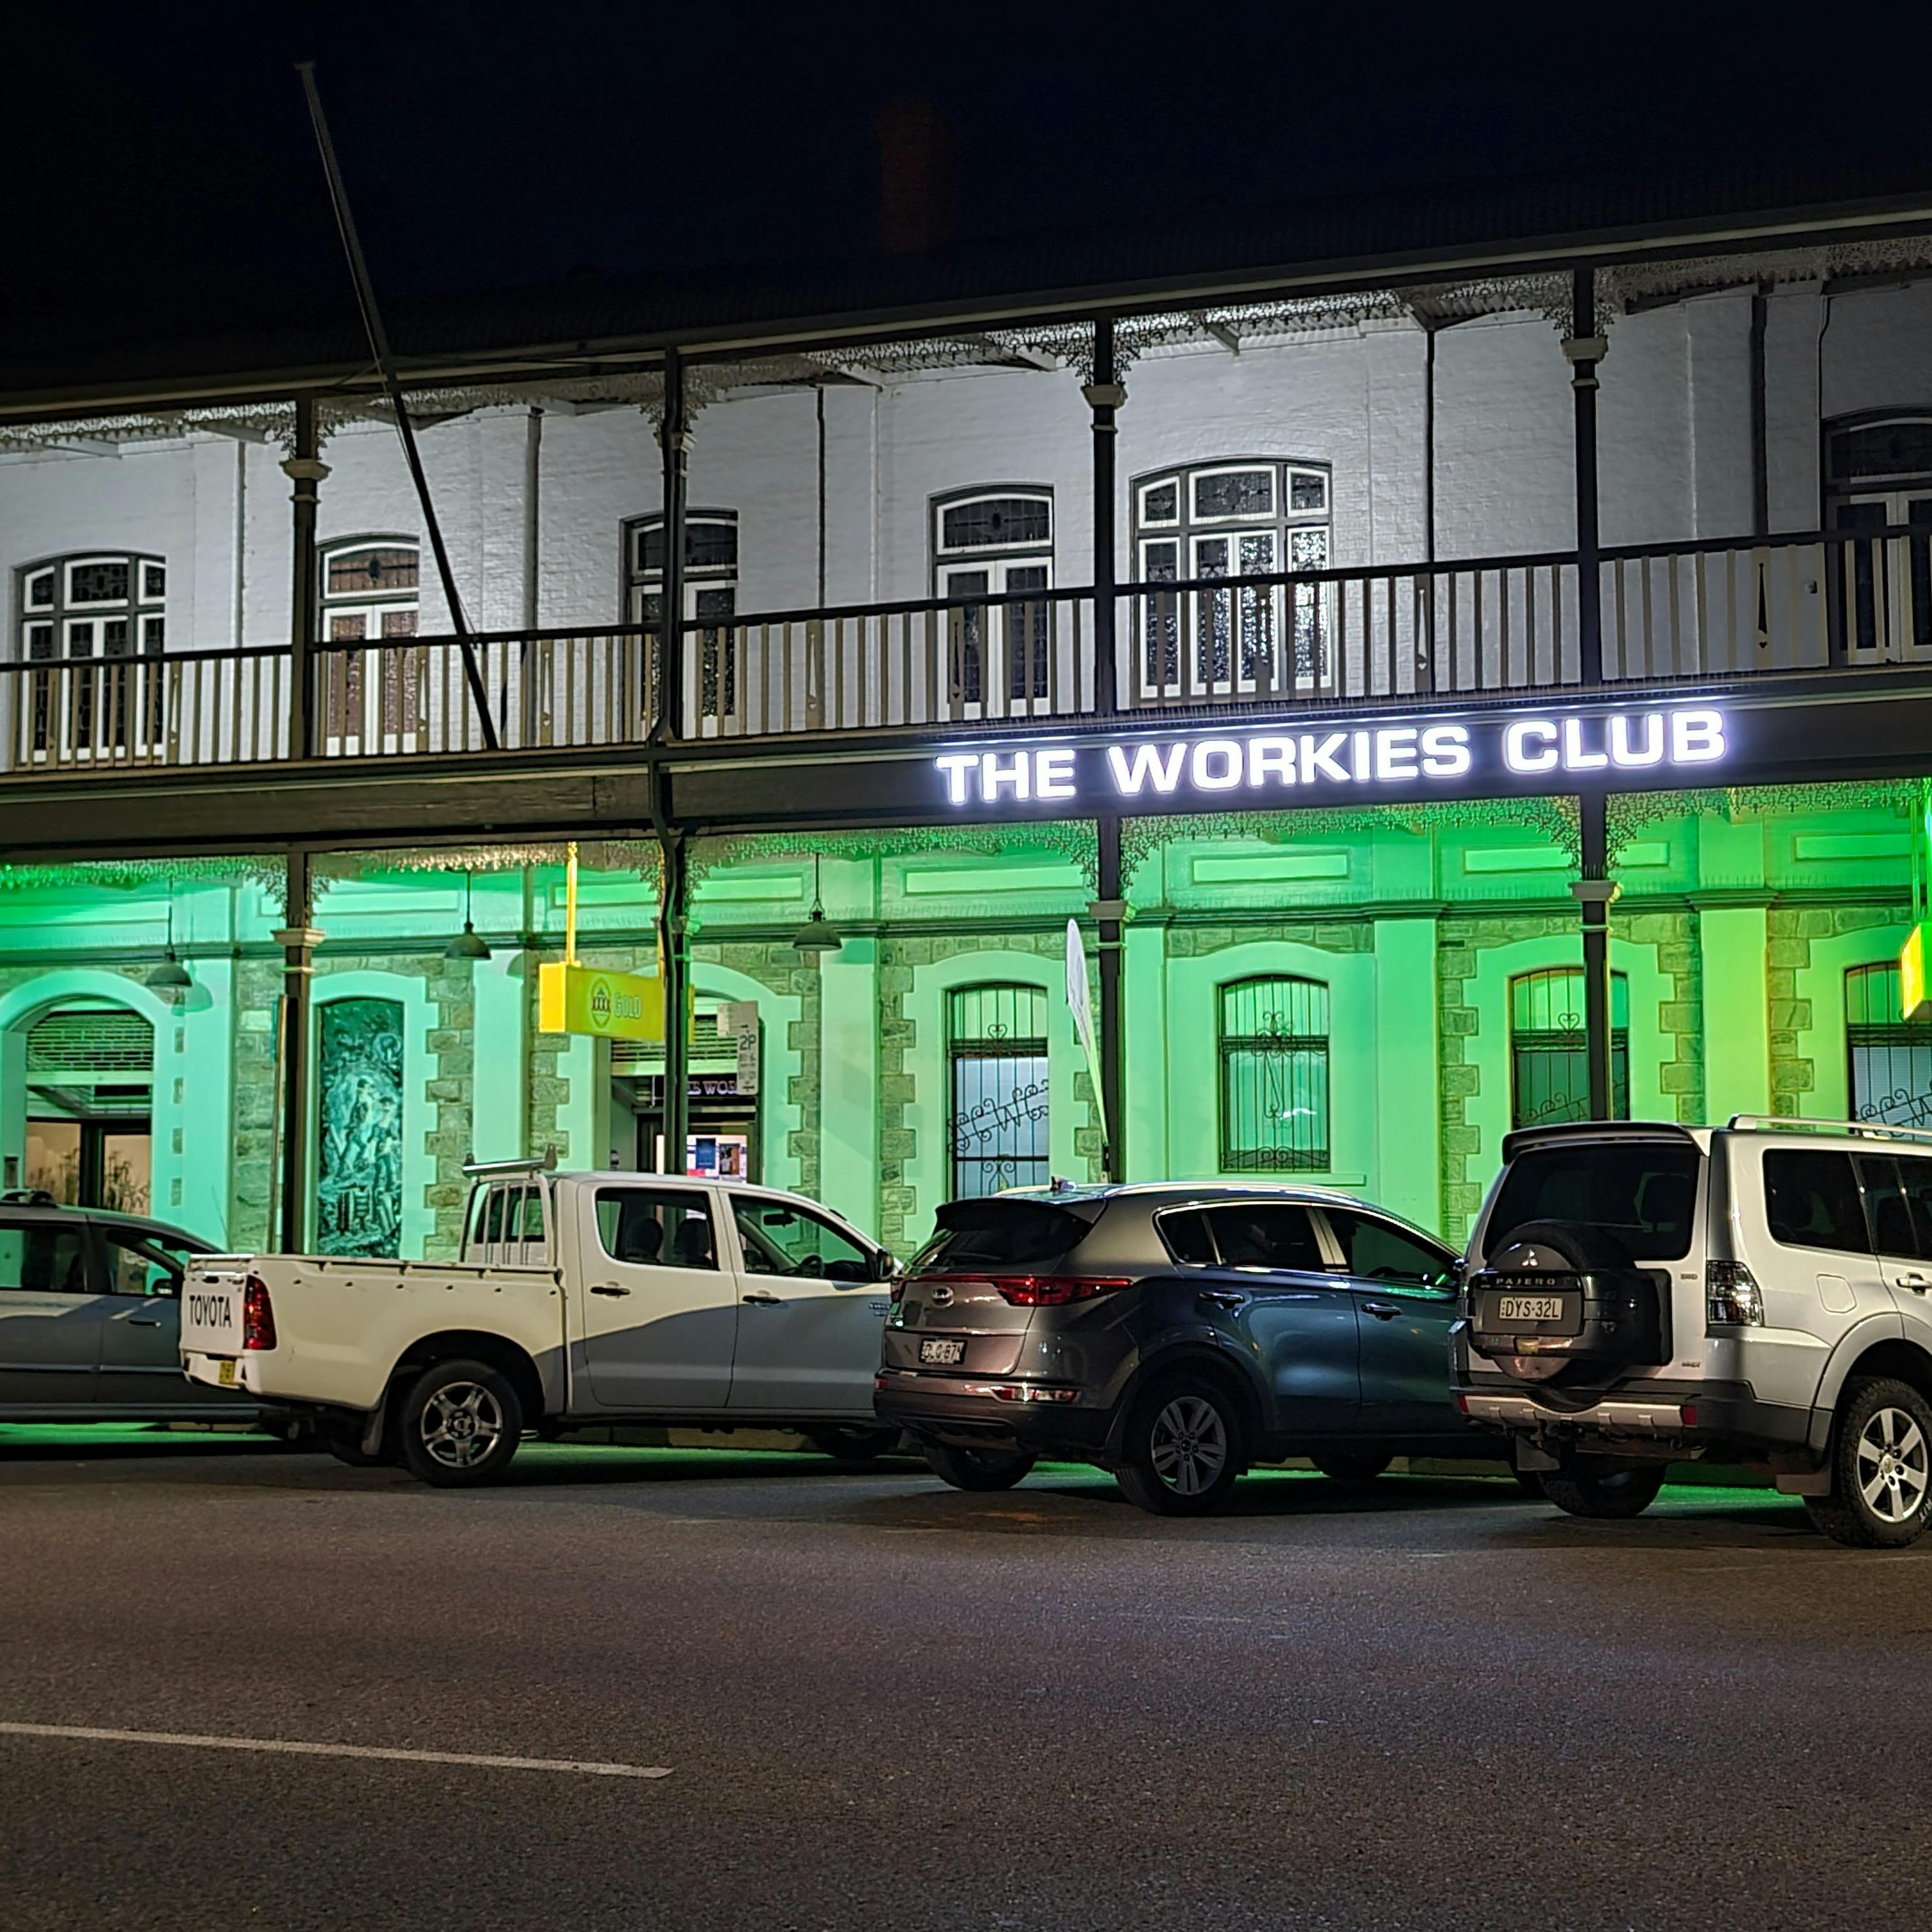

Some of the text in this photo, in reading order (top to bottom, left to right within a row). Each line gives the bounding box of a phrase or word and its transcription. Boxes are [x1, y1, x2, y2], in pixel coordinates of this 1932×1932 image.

[936, 710, 1726, 804] THE WORKIES CLUB
[739, 1034, 756, 1050] 2P
[189, 1294, 232, 1328] TOYOTA
